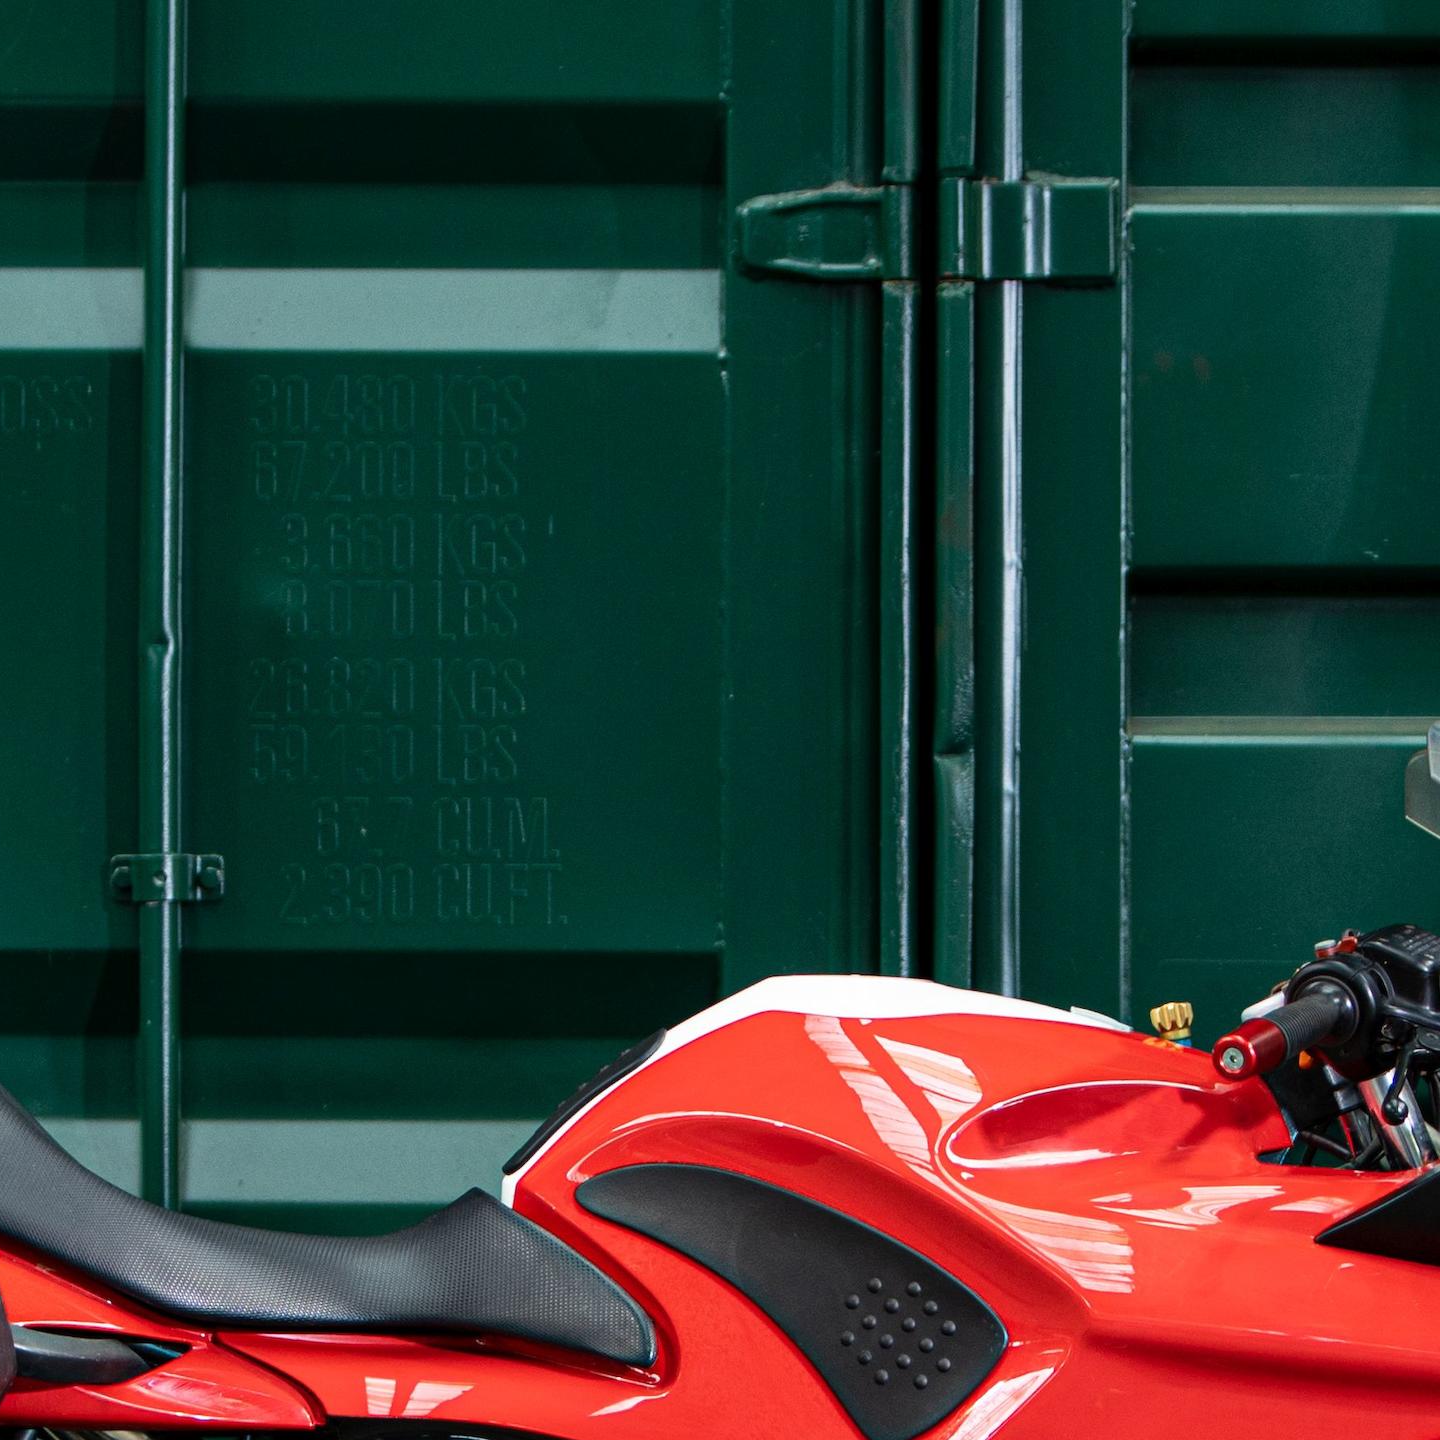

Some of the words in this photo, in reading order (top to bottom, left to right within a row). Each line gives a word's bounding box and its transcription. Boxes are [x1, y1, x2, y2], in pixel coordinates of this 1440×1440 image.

[249, 374, 417, 437] 30.480
[434, 374, 529, 437] KGS
[250, 441, 417, 504] 67.200
[435, 441, 520, 504] LBS
[279, 512, 417, 576] 3.660
[434, 512, 529, 576] KGS
[281, 579, 417, 640] 8.070
[435, 579, 520, 641] LBS
[248, 656, 417, 721] 26.820
[434, 657, 529, 721] KGS
[248, 724, 417, 784] 59.130
[435, 724, 520, 784] LBS
[278, 863, 417, 926] 2.390
